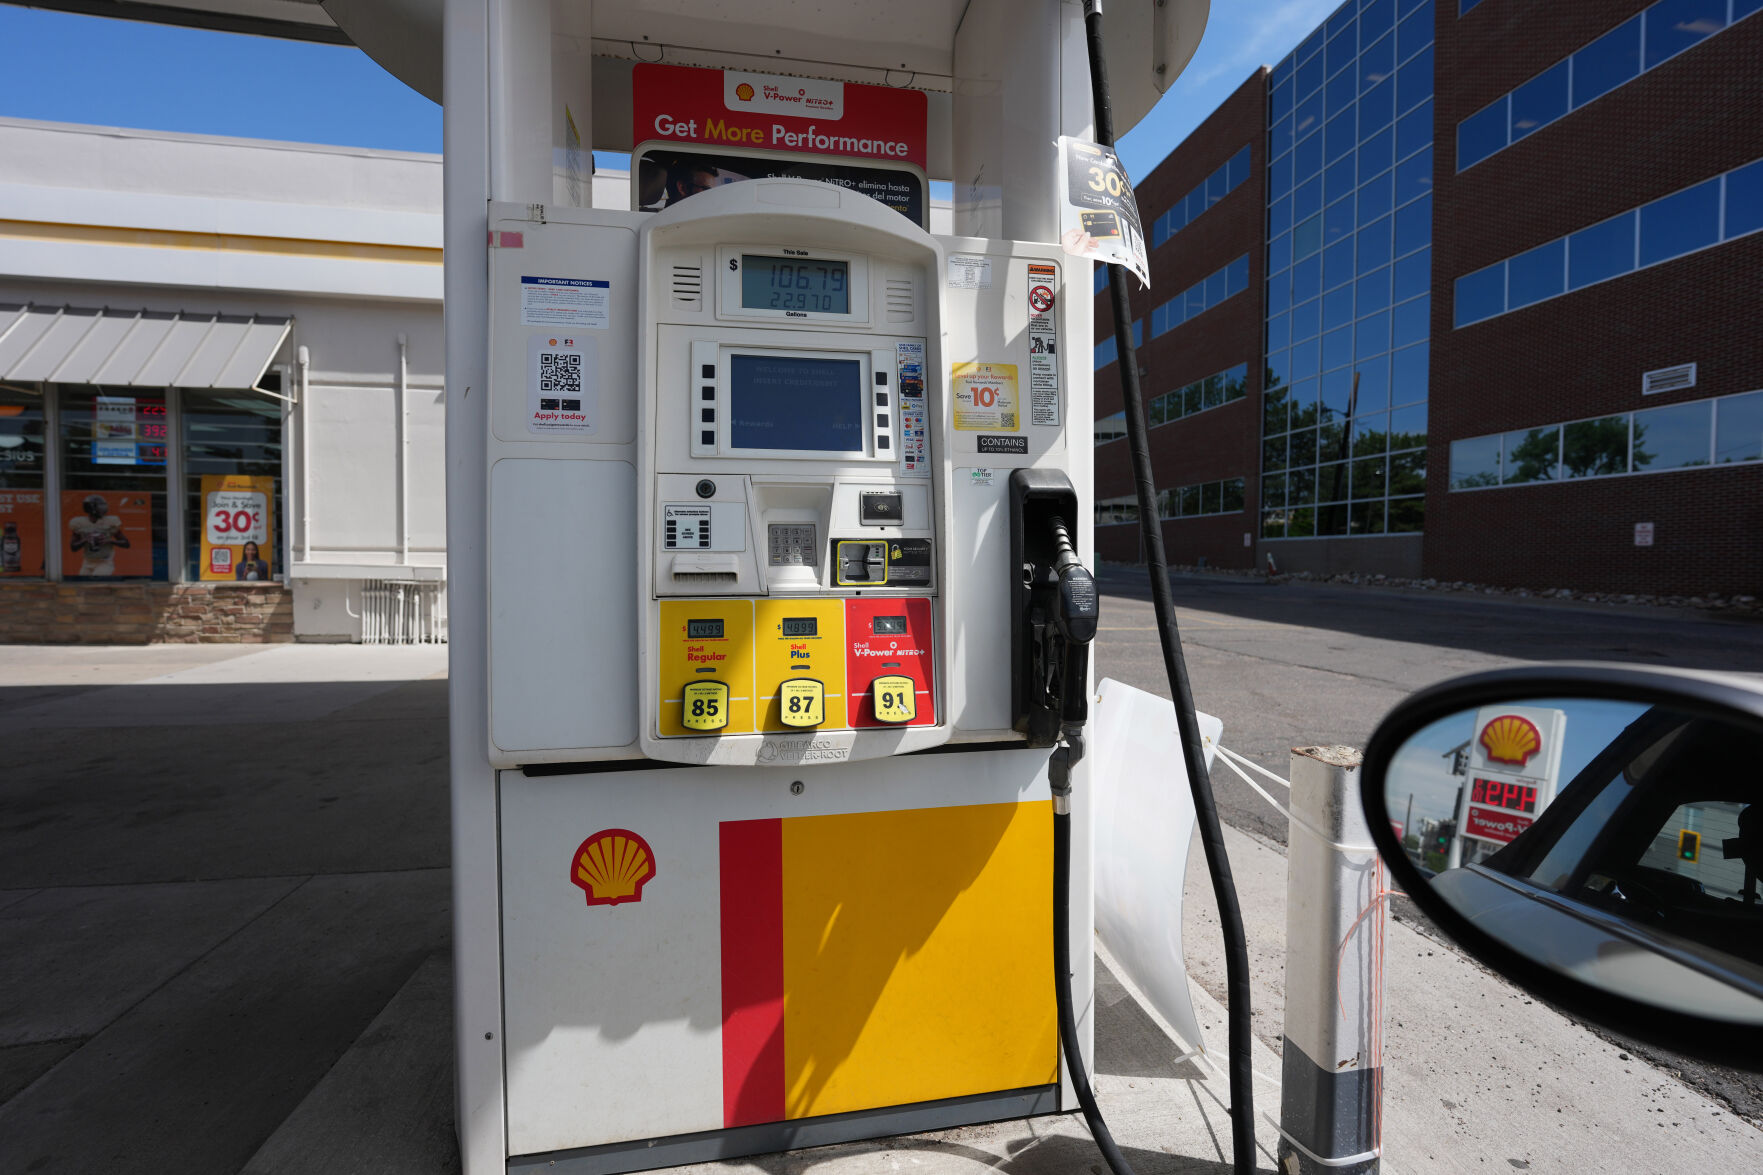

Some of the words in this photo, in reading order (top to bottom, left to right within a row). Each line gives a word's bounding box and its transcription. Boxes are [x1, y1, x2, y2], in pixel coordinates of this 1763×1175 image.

[763, 92, 803, 103] V-Power
[654, 114, 697, 138] Get
[704, 118, 765, 144] More
[772, 125, 909, 157] Performance
[858, 181, 887, 190] elimina
[888, 182, 910, 192] hasta
[886, 194, 910, 203] motor
[729, 258, 739, 273] $
[537, 278, 569, 286] IMPORTANT
[770, 264, 846, 292] 106.79
[770, 291, 832, 311] 22.970
[956, 392, 972, 400] Save
[970, 386, 1000, 408] 10¢
[534, 411, 560, 421] Apply
[561, 413, 586, 422] today
[981, 437, 1025, 447] CONTAINS
[231, 501, 239, 509] &
[240, 501, 262, 509] Save
[687, 652, 727, 664] Regular
[790, 650, 811, 659] Plus
[854, 648, 894, 657] V-Power
[788, 695, 815, 714] 87
[881, 691, 905, 710] 91
[691, 698, 719, 717] 85
